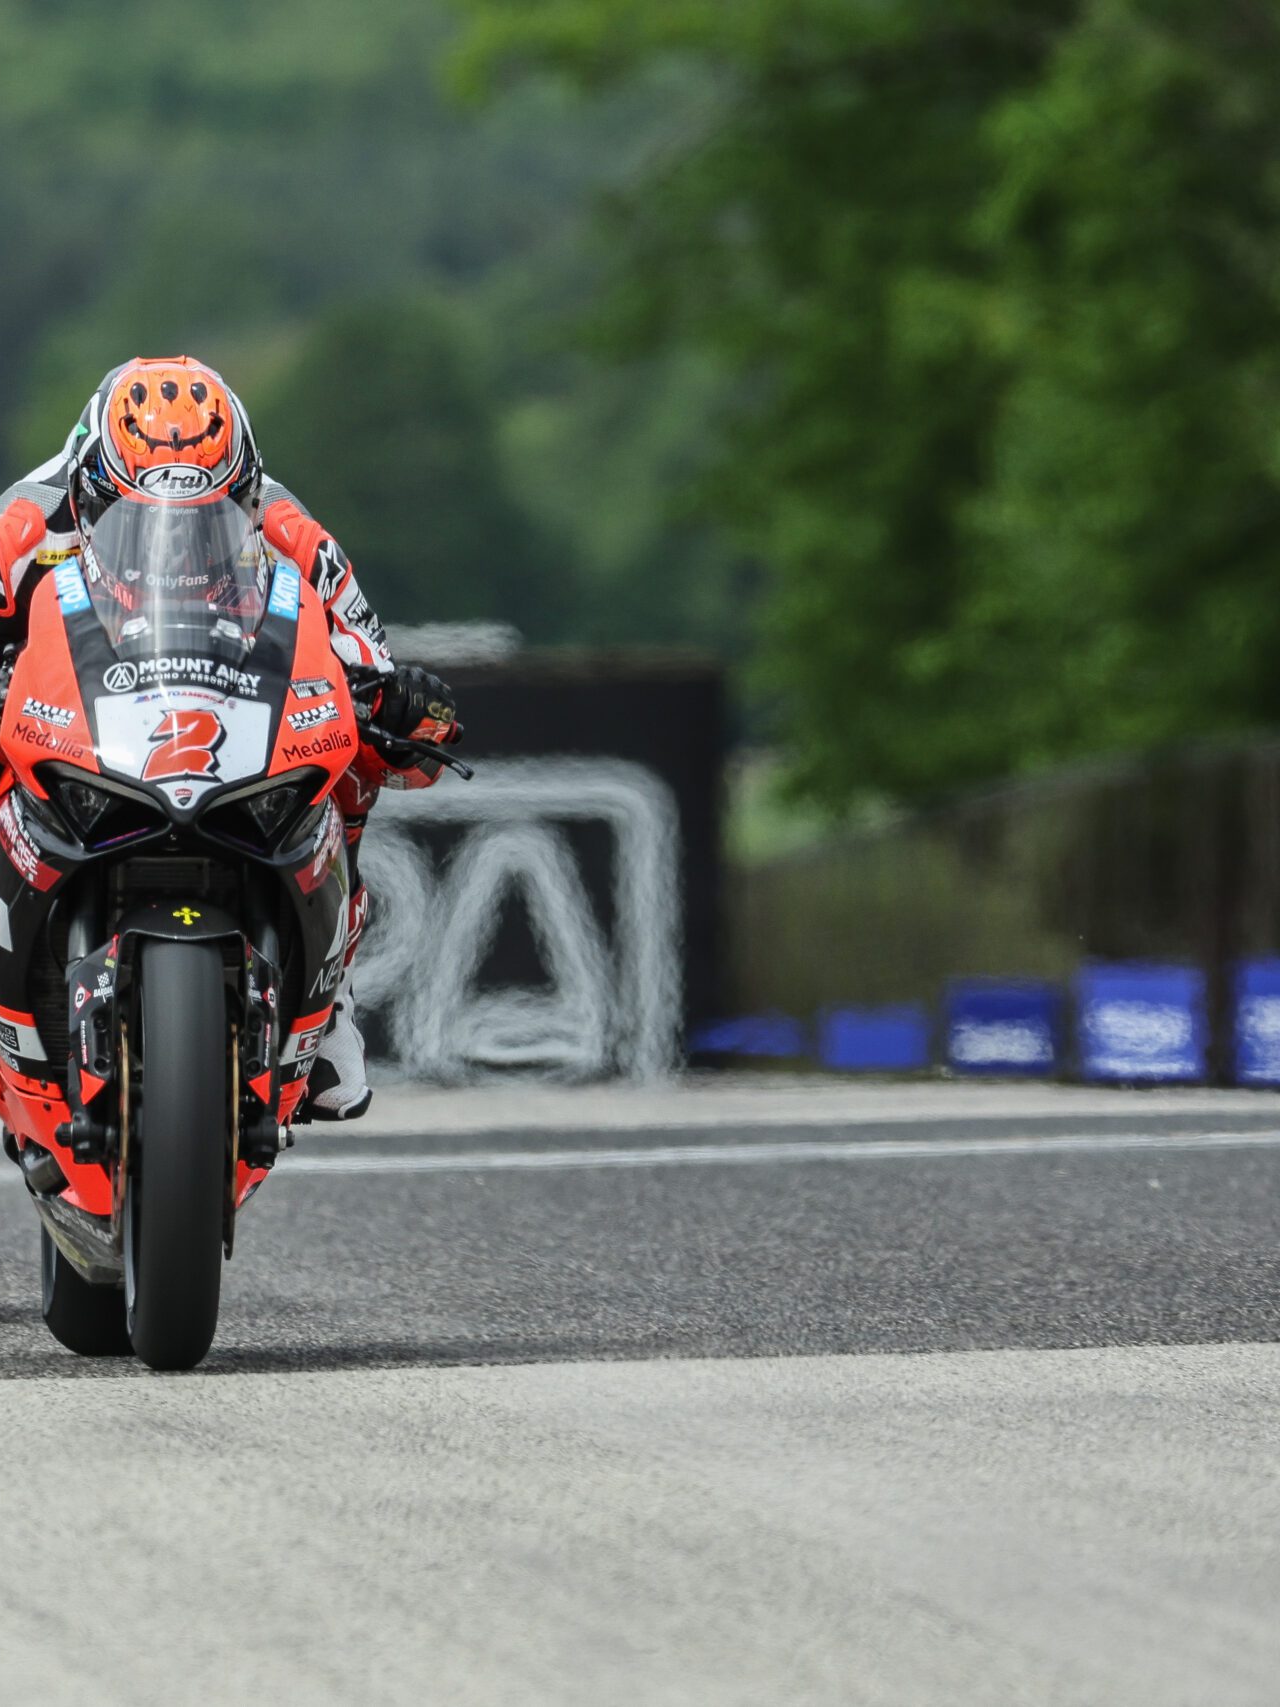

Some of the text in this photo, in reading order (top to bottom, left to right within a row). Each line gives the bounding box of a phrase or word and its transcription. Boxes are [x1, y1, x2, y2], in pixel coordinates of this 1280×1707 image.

[143, 469, 206, 490] Arai
[55, 566, 86, 605] KATO
[146, 572, 209, 590] OnlyFans
[272, 571, 298, 611] KATO
[139, 657, 214, 675] MOUNT
[139, 672, 179, 684] CASINO
[11, 722, 84, 759] Medallia
[141, 708, 227, 784] 2
[282, 730, 352, 763] Medallia
